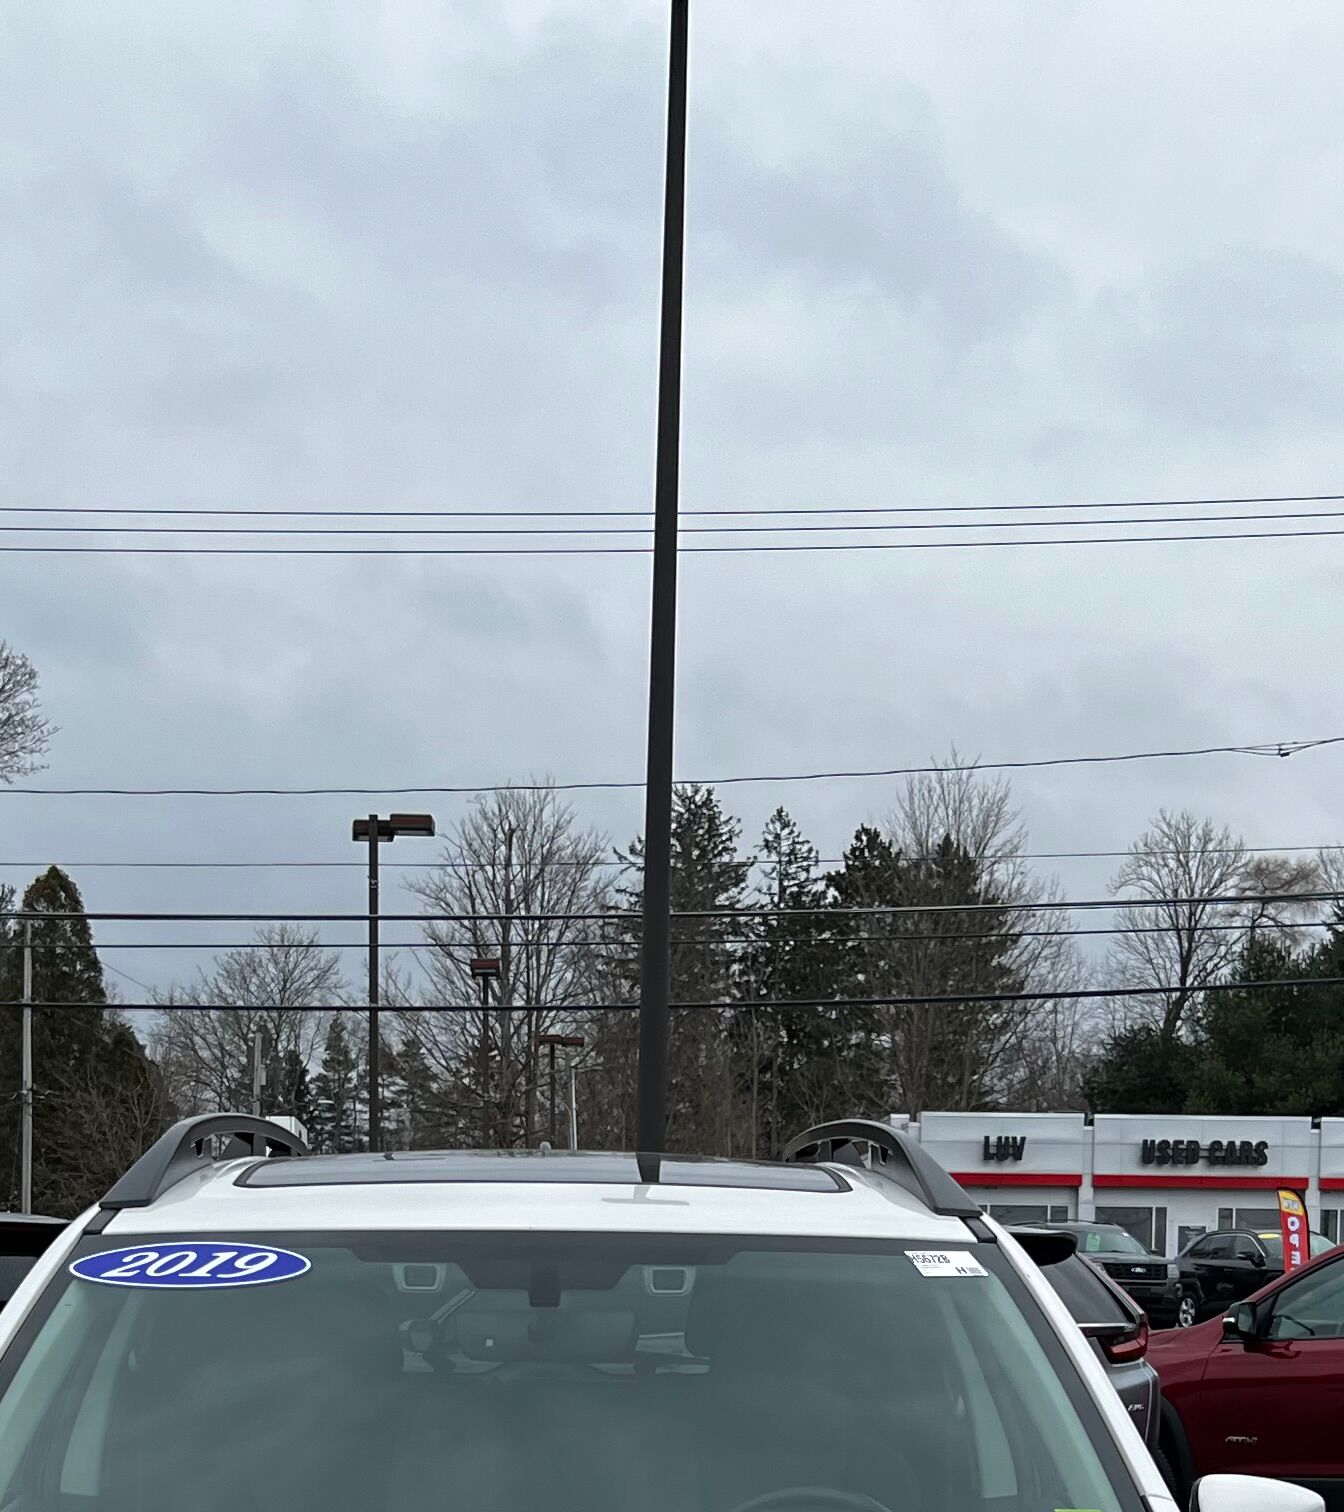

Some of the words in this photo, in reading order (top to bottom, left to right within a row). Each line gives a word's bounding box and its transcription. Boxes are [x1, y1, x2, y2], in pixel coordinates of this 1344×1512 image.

[983, 1136, 1026, 1161] LUV
[1141, 1139, 1200, 1165] USED
[1209, 1140, 1269, 1166] CARS
[100, 1251, 278, 1278] 2019
